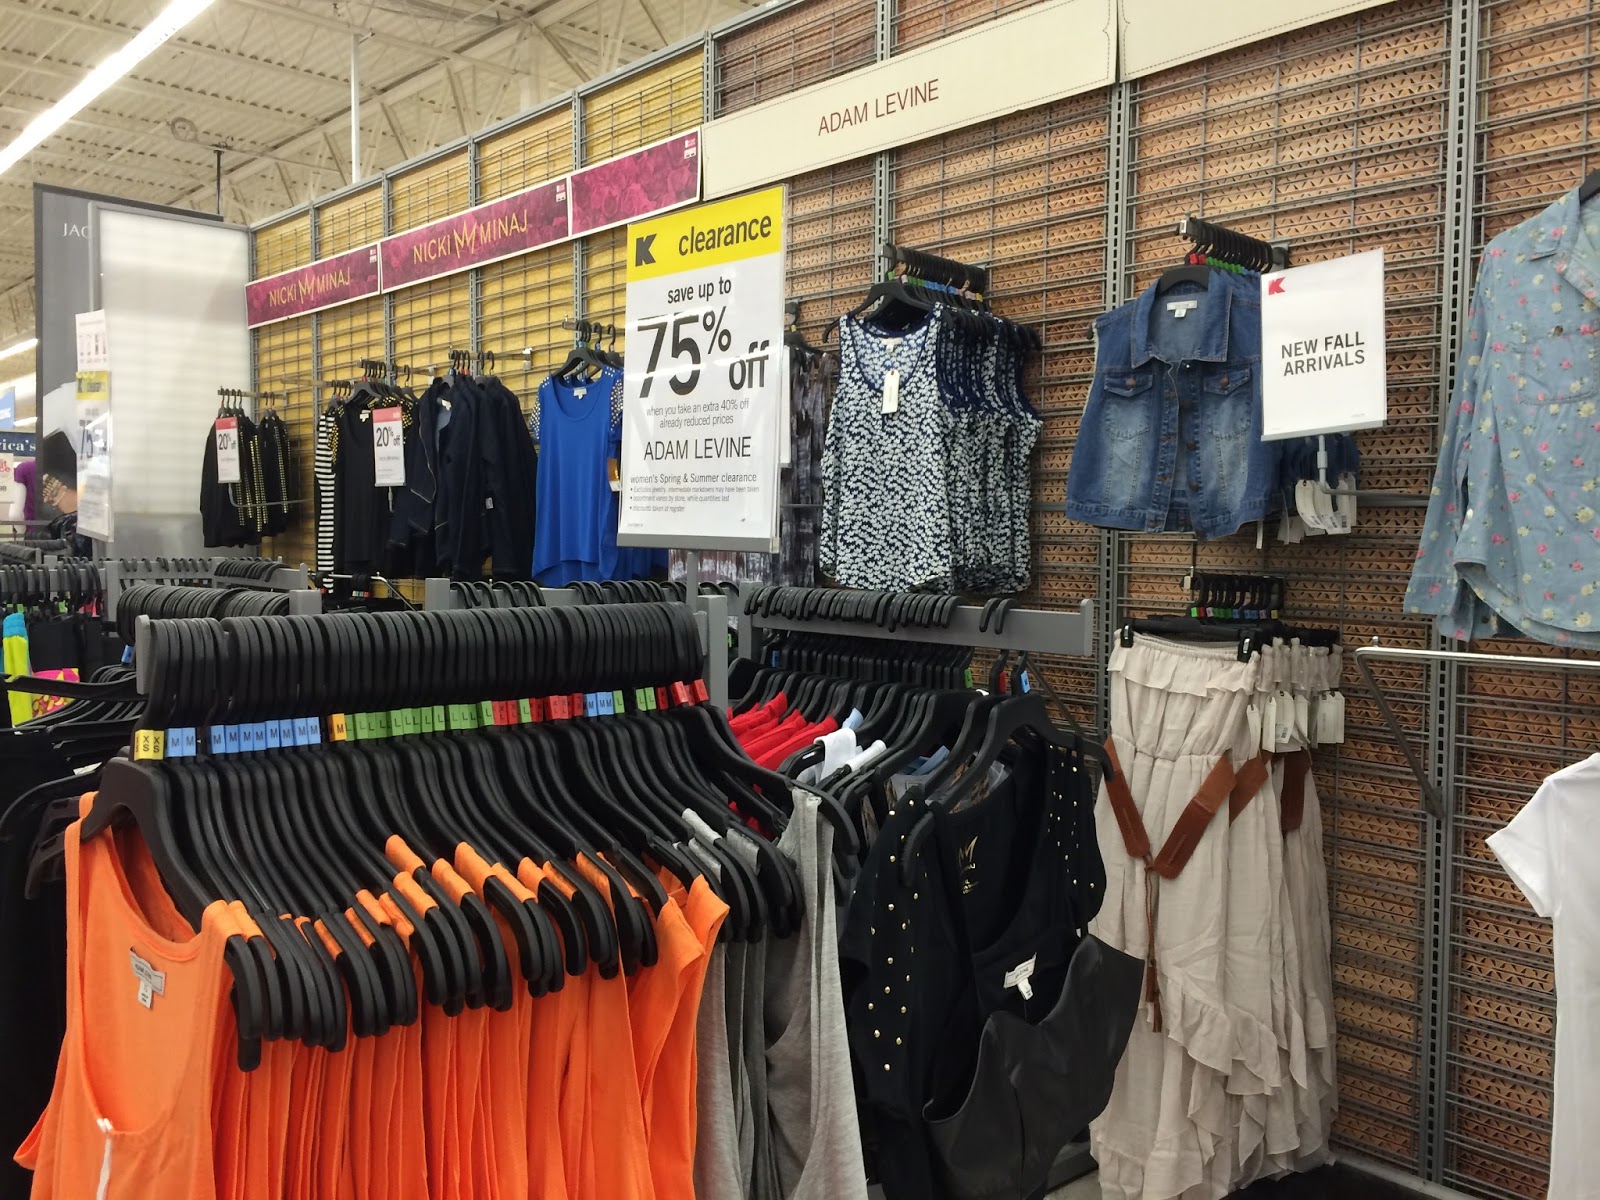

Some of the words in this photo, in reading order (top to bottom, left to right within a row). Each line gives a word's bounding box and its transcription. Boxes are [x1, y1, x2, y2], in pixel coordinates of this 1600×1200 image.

[818, 102, 868, 136] ADAM
[875, 78, 939, 118] LEVINE
[413, 234, 450, 265] NICKI
[479, 209, 528, 245] MINAJ
[678, 215, 772, 256] clearance
[269, 283, 297, 307] NICKI
[317, 266, 351, 294] MINAJ
[667, 286, 694, 304] save
[698, 281, 714, 302] up
[718, 276, 732, 295] to
[1281, 338, 1318, 359] NEW
[1324, 331, 1365, 351] FALL
[728, 339, 770, 391] off
[1283, 349, 1365, 377] ARRIVALS
[647, 405, 663, 417] when
[665, 406, 676, 418] you
[677, 403, 691, 415] take
[692, 405, 701, 414] an
[703, 401, 719, 413] extra
[720, 399, 738, 411] 40%
[739, 398, 749, 410] off
[659, 417, 682, 429] already
[683, 415, 711, 427] reduced
[712, 414, 734, 426] prices
[643, 440, 688, 461] ADAM
[694, 436, 752, 459] LEVINE
[630, 474, 658, 484] women's
[659, 473, 682, 485] Spring
[683, 473, 689, 483] &
[690, 473, 719, 483] Summer
[721, 472, 757, 482] clearance
